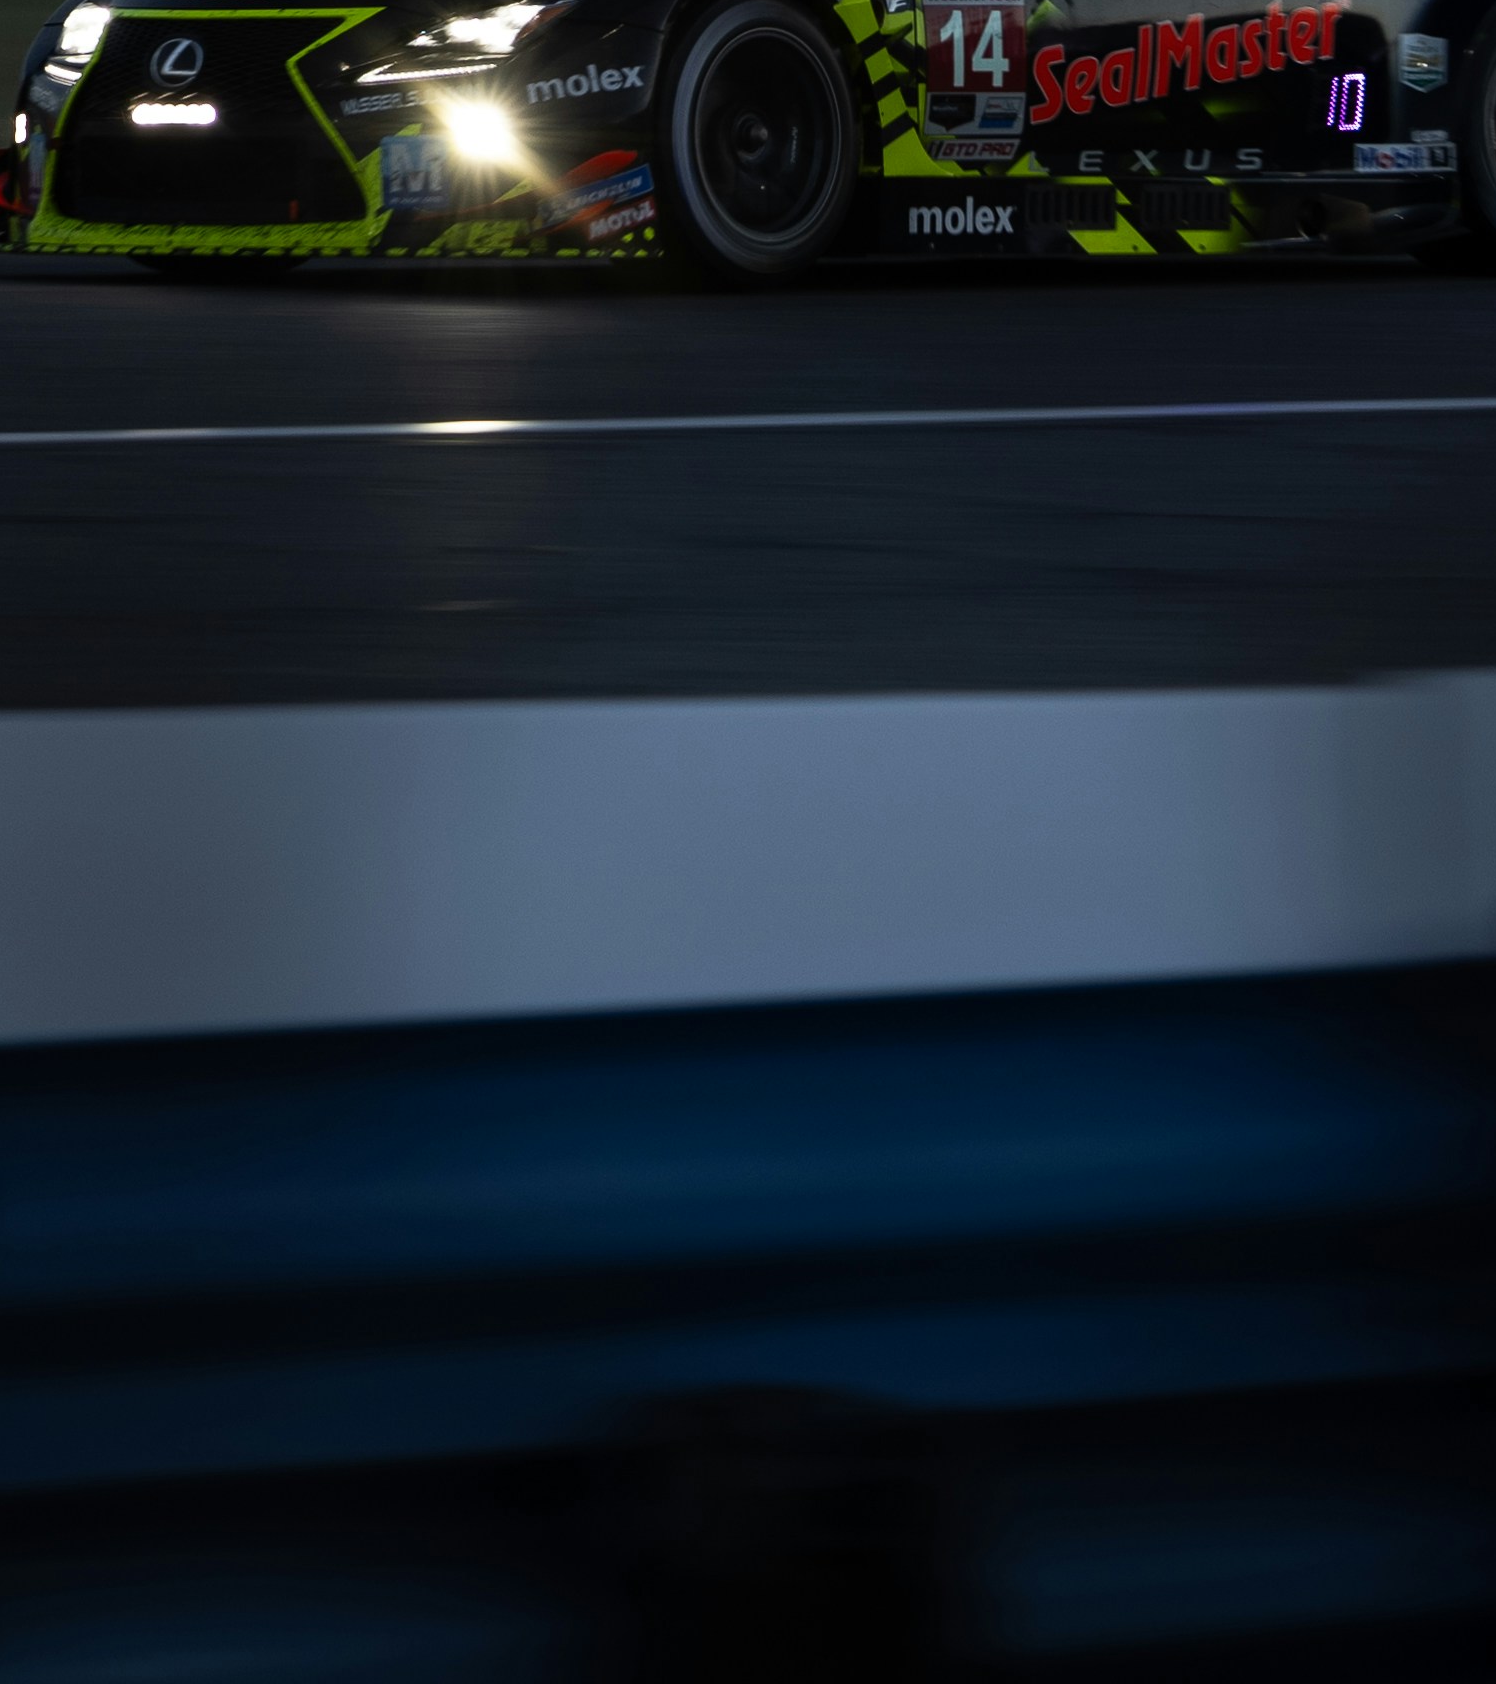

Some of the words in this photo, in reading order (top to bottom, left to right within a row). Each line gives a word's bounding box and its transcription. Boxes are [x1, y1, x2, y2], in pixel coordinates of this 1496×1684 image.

[940, 9, 1010, 88] 14
[1030, 0, 1343, 125] SealMaster
[526, 64, 645, 105] molex
[1326, 72, 1367, 132] 10
[943, 143, 978, 157] GTD
[979, 142, 1014, 156] PRO
[1029, 147, 1264, 173] LEXUS
[589, 201, 655, 242] MOTUL
[908, 196, 1015, 235] molex
